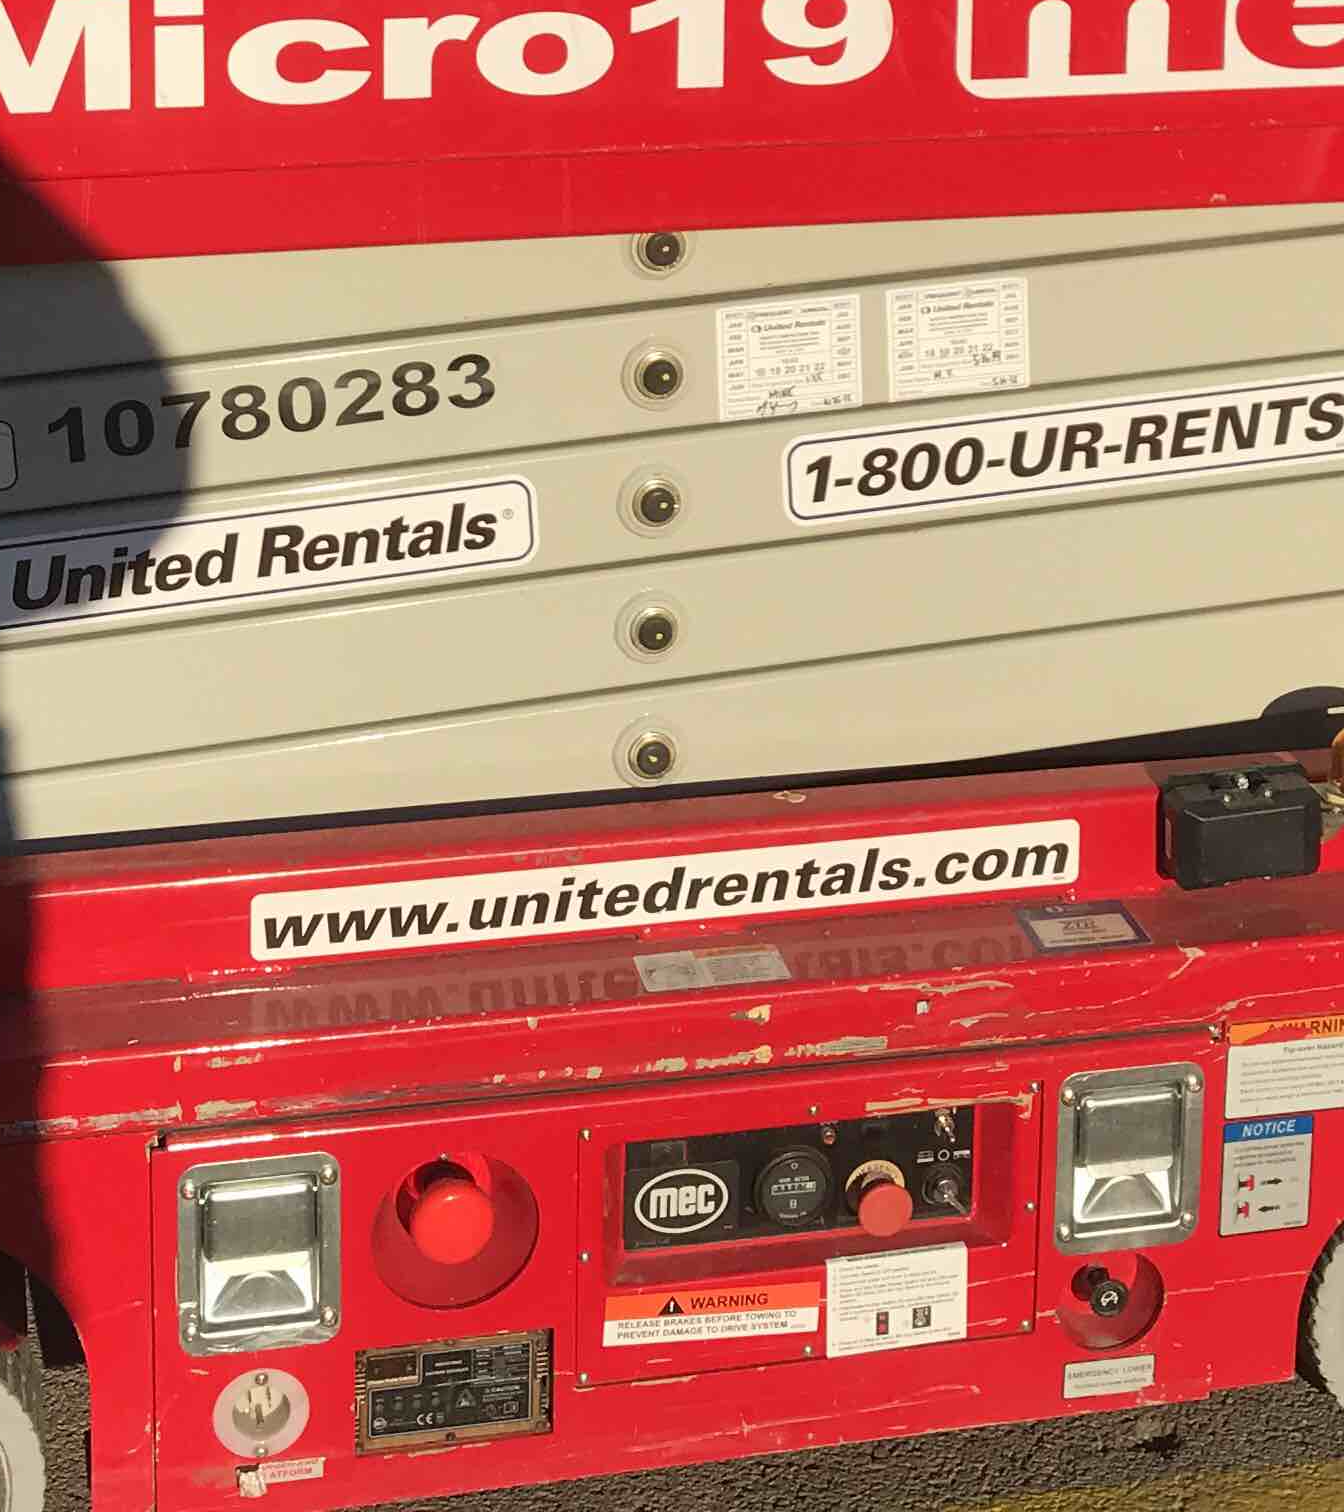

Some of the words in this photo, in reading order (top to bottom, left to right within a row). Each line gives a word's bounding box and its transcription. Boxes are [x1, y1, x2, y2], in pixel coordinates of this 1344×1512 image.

[47, 352, 497, 464] 10780283
[10, 533, 239, 612] United
[256, 502, 499, 579] Rentals
[262, 836, 1070, 949] www.unitedrentals.com
[1242, 1119, 1297, 1137] NOTICE
[648, 1183, 716, 1220] mec
[689, 1293, 769, 1310] WARNING
[616, 1329, 661, 1340] PREVENT
[662, 1326, 703, 1337] DAMAGE
[706, 1325, 719, 1334] TO
[720, 1323, 748, 1333] DRIVE
[750, 1320, 788, 1331] SYSTEM
[617, 1319, 662, 1330] RELEASE
[663, 1317, 703, 1327] BRAKES
[705, 1314, 742, 1324] BEFORE
[745, 1311, 782, 1321] TOWING
[783, 1310, 798, 1318] TO
